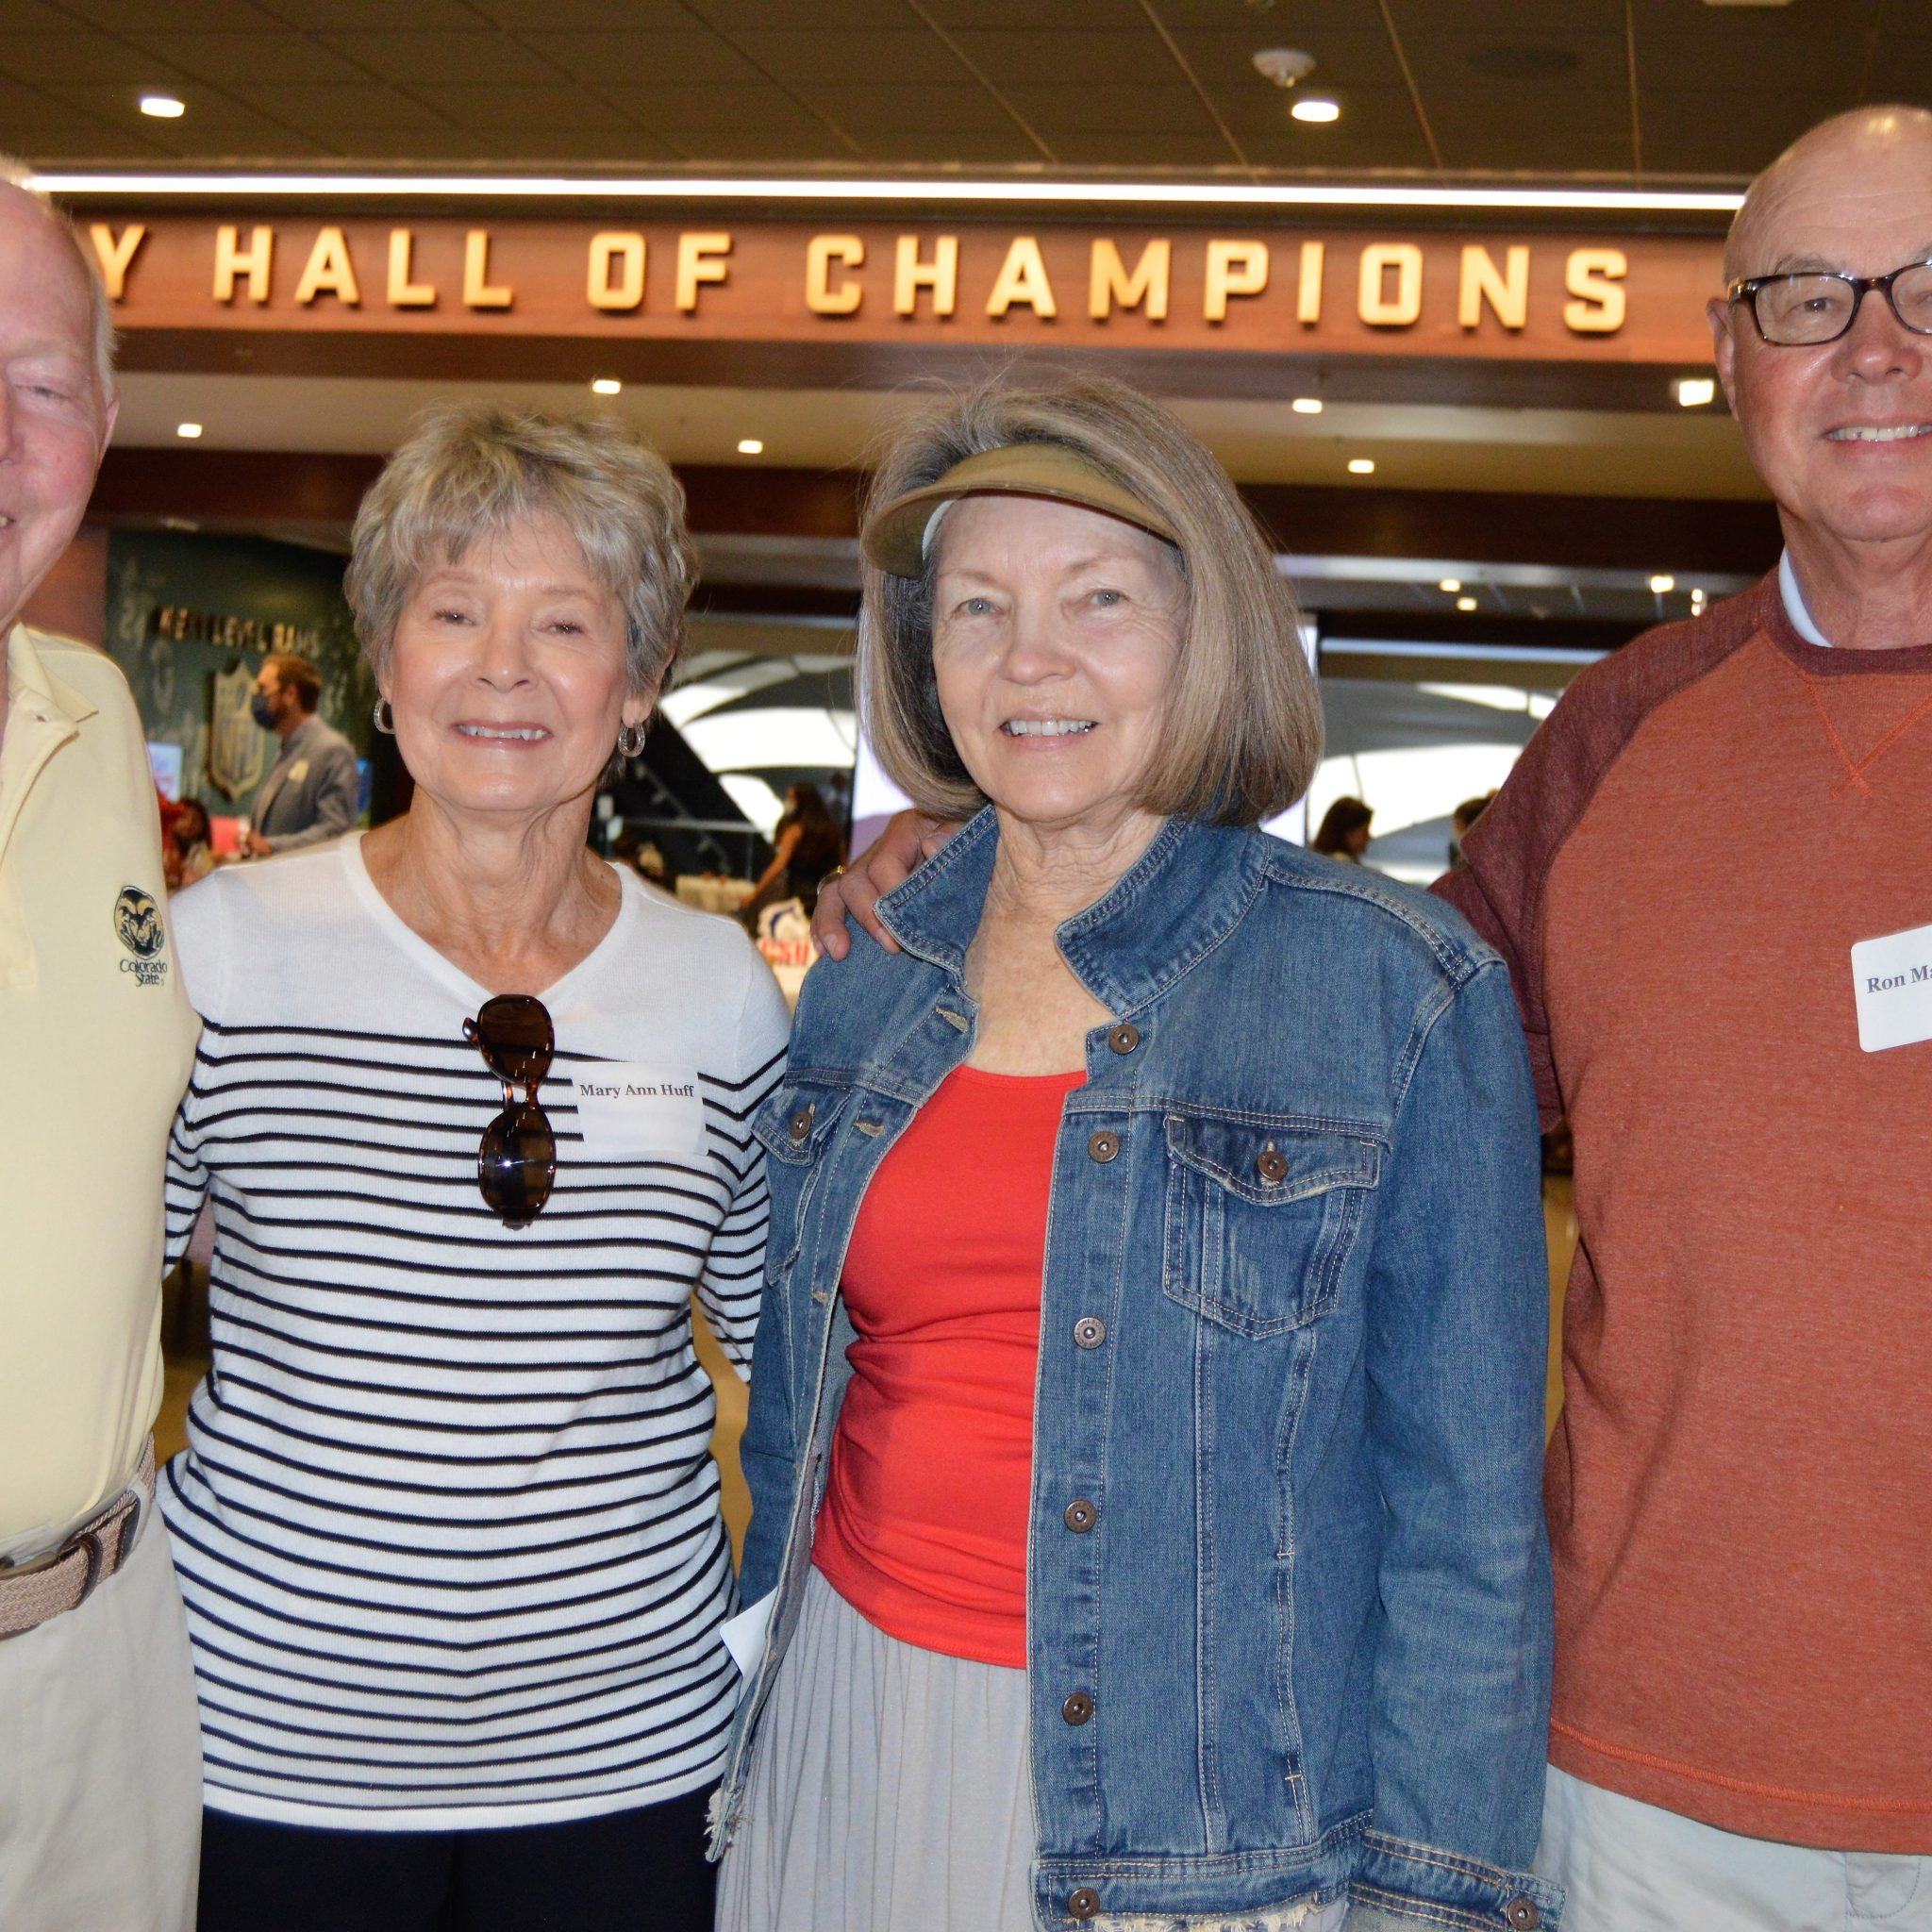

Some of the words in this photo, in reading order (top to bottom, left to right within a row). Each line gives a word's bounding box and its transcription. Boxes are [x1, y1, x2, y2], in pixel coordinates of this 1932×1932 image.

[212, 225, 514, 309] HALL
[587, 231, 732, 312] OF
[805, 233, 1629, 333] CHAMPIONS
[120, 958, 168, 974] Colorado
[135, 972, 160, 987] State
[1866, 974, 1907, 994] Ron
[579, 1084, 622, 1099] Mary
[625, 1084, 658, 1096] Ann
[661, 1084, 695, 1098] Huff
